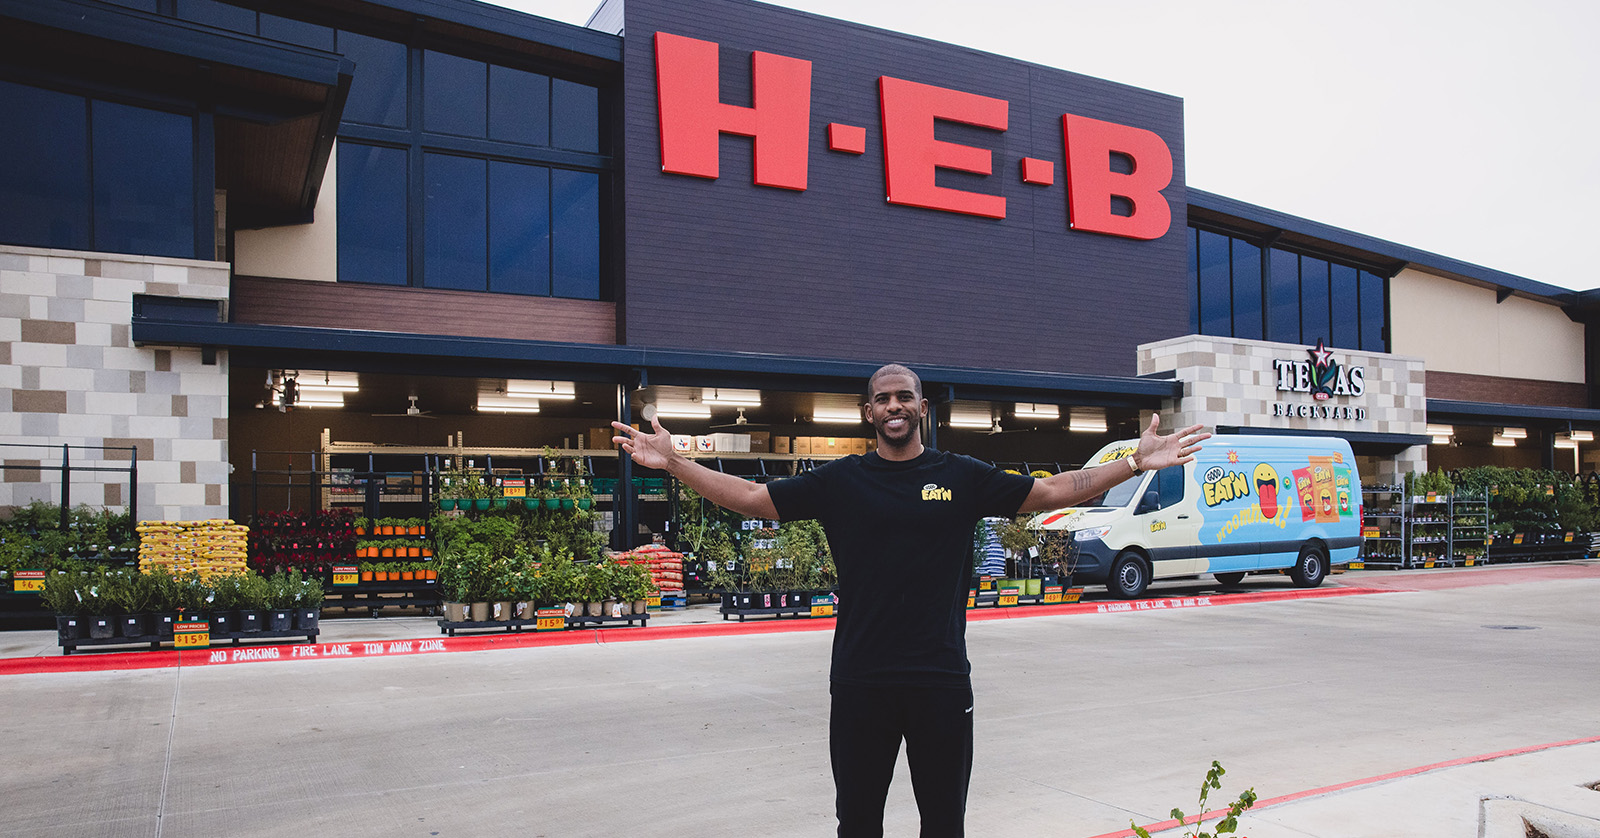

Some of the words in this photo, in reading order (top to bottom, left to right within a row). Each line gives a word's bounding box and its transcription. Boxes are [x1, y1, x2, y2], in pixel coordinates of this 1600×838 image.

[654, 31, 1173, 241] H-E-B
[1273, 403, 1366, 420] BACKYARD
[1207, 468, 1221, 482] GOOD
[921, 487, 952, 501] EAT'N
[1202, 470, 1250, 507] EAT'N
[22, 580, 34, 589] $6
[1136, 601, 1150, 610] FIRE
[1150, 600, 1167, 609] LANE
[539, 618, 564, 627] $1597
[177, 634, 209, 644] $1597
[210, 651, 227, 662] NO
[232, 647, 280, 661] PARKING
[292, 645, 317, 657] FIRE
[323, 644, 352, 656] LANE
[363, 643, 384, 654] TOW
[389, 641, 413, 653] AWAY
[418, 639, 446, 651] ZONE
